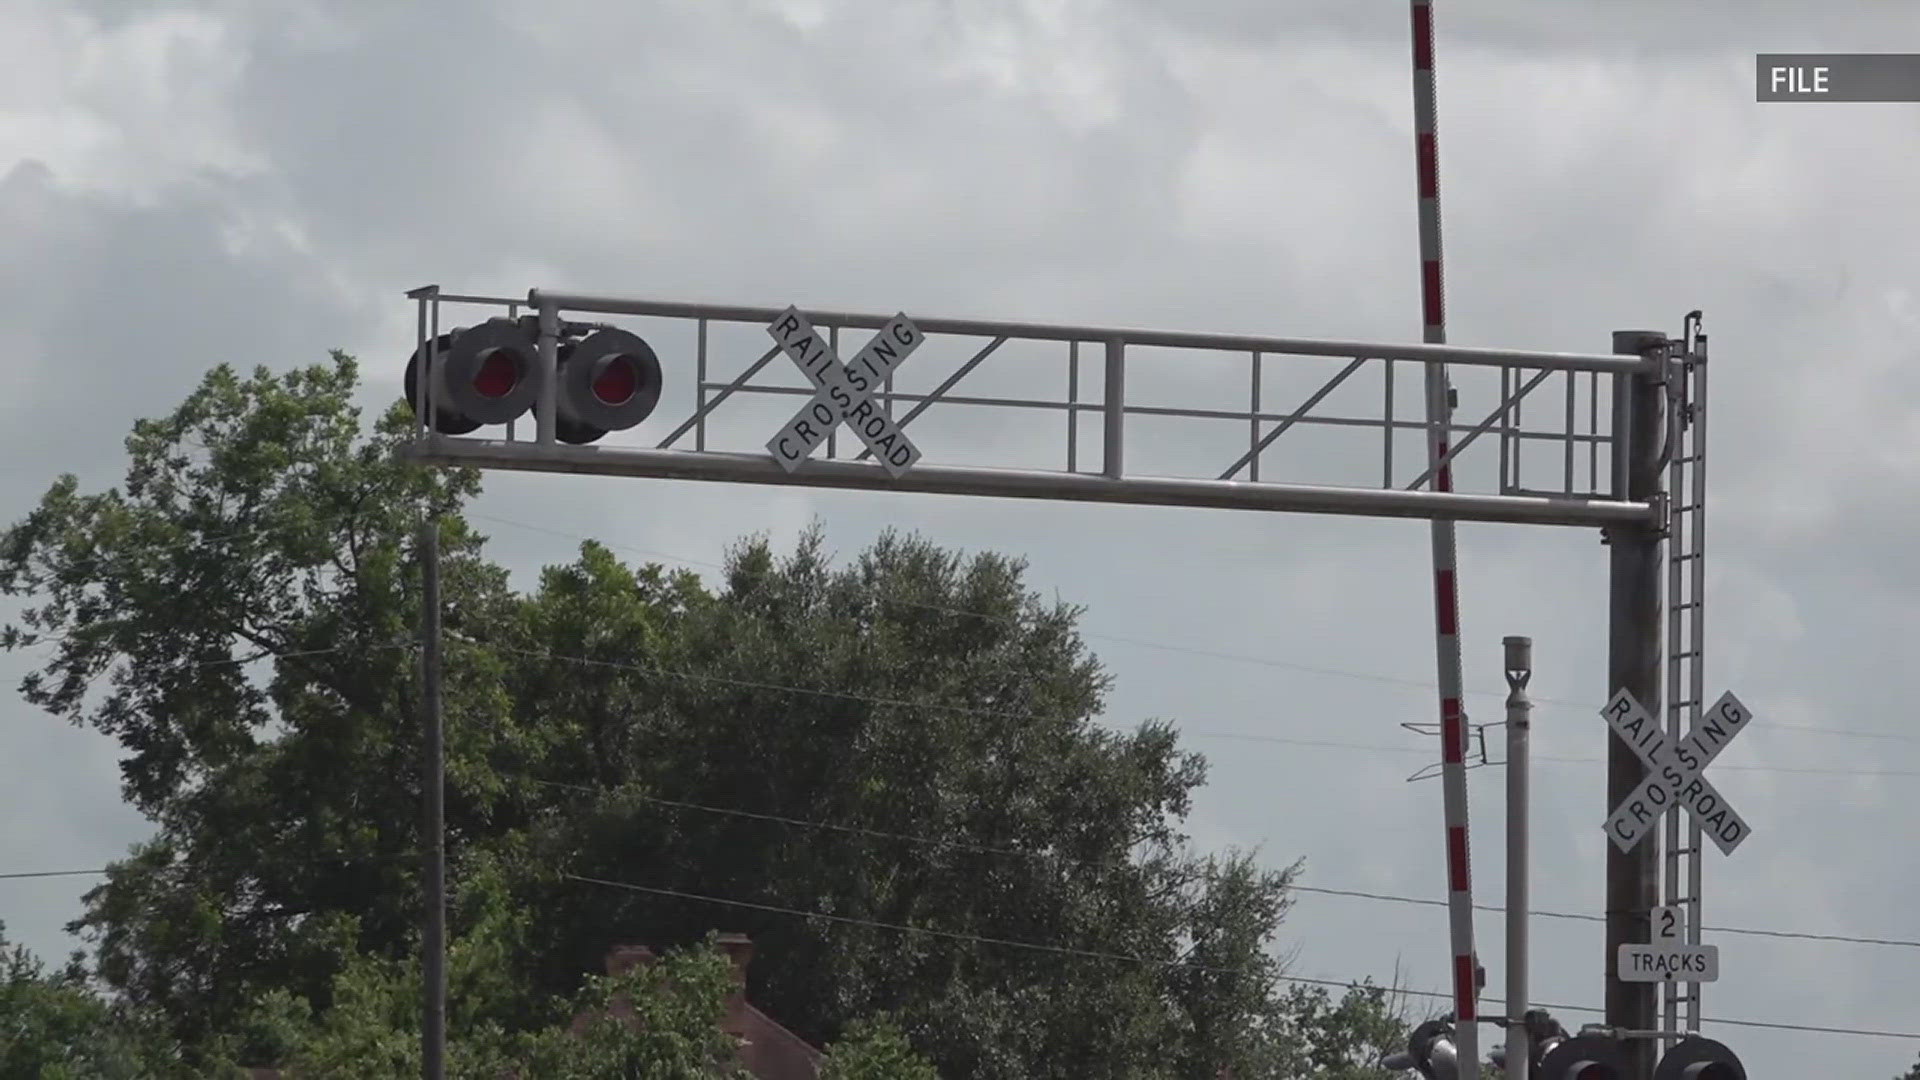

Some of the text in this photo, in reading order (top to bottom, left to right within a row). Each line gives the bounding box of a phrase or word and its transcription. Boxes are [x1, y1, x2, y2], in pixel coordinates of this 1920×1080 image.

[776, 315, 910, 467] RAIL ROAD
[779, 323, 913, 461] CROSSING
[1609, 697, 1740, 842] RAIL ROAD
[1615, 703, 1741, 840] CROSSING
[1632, 953, 1706, 972] TRACKS
[1661, 910, 1675, 937] 2
